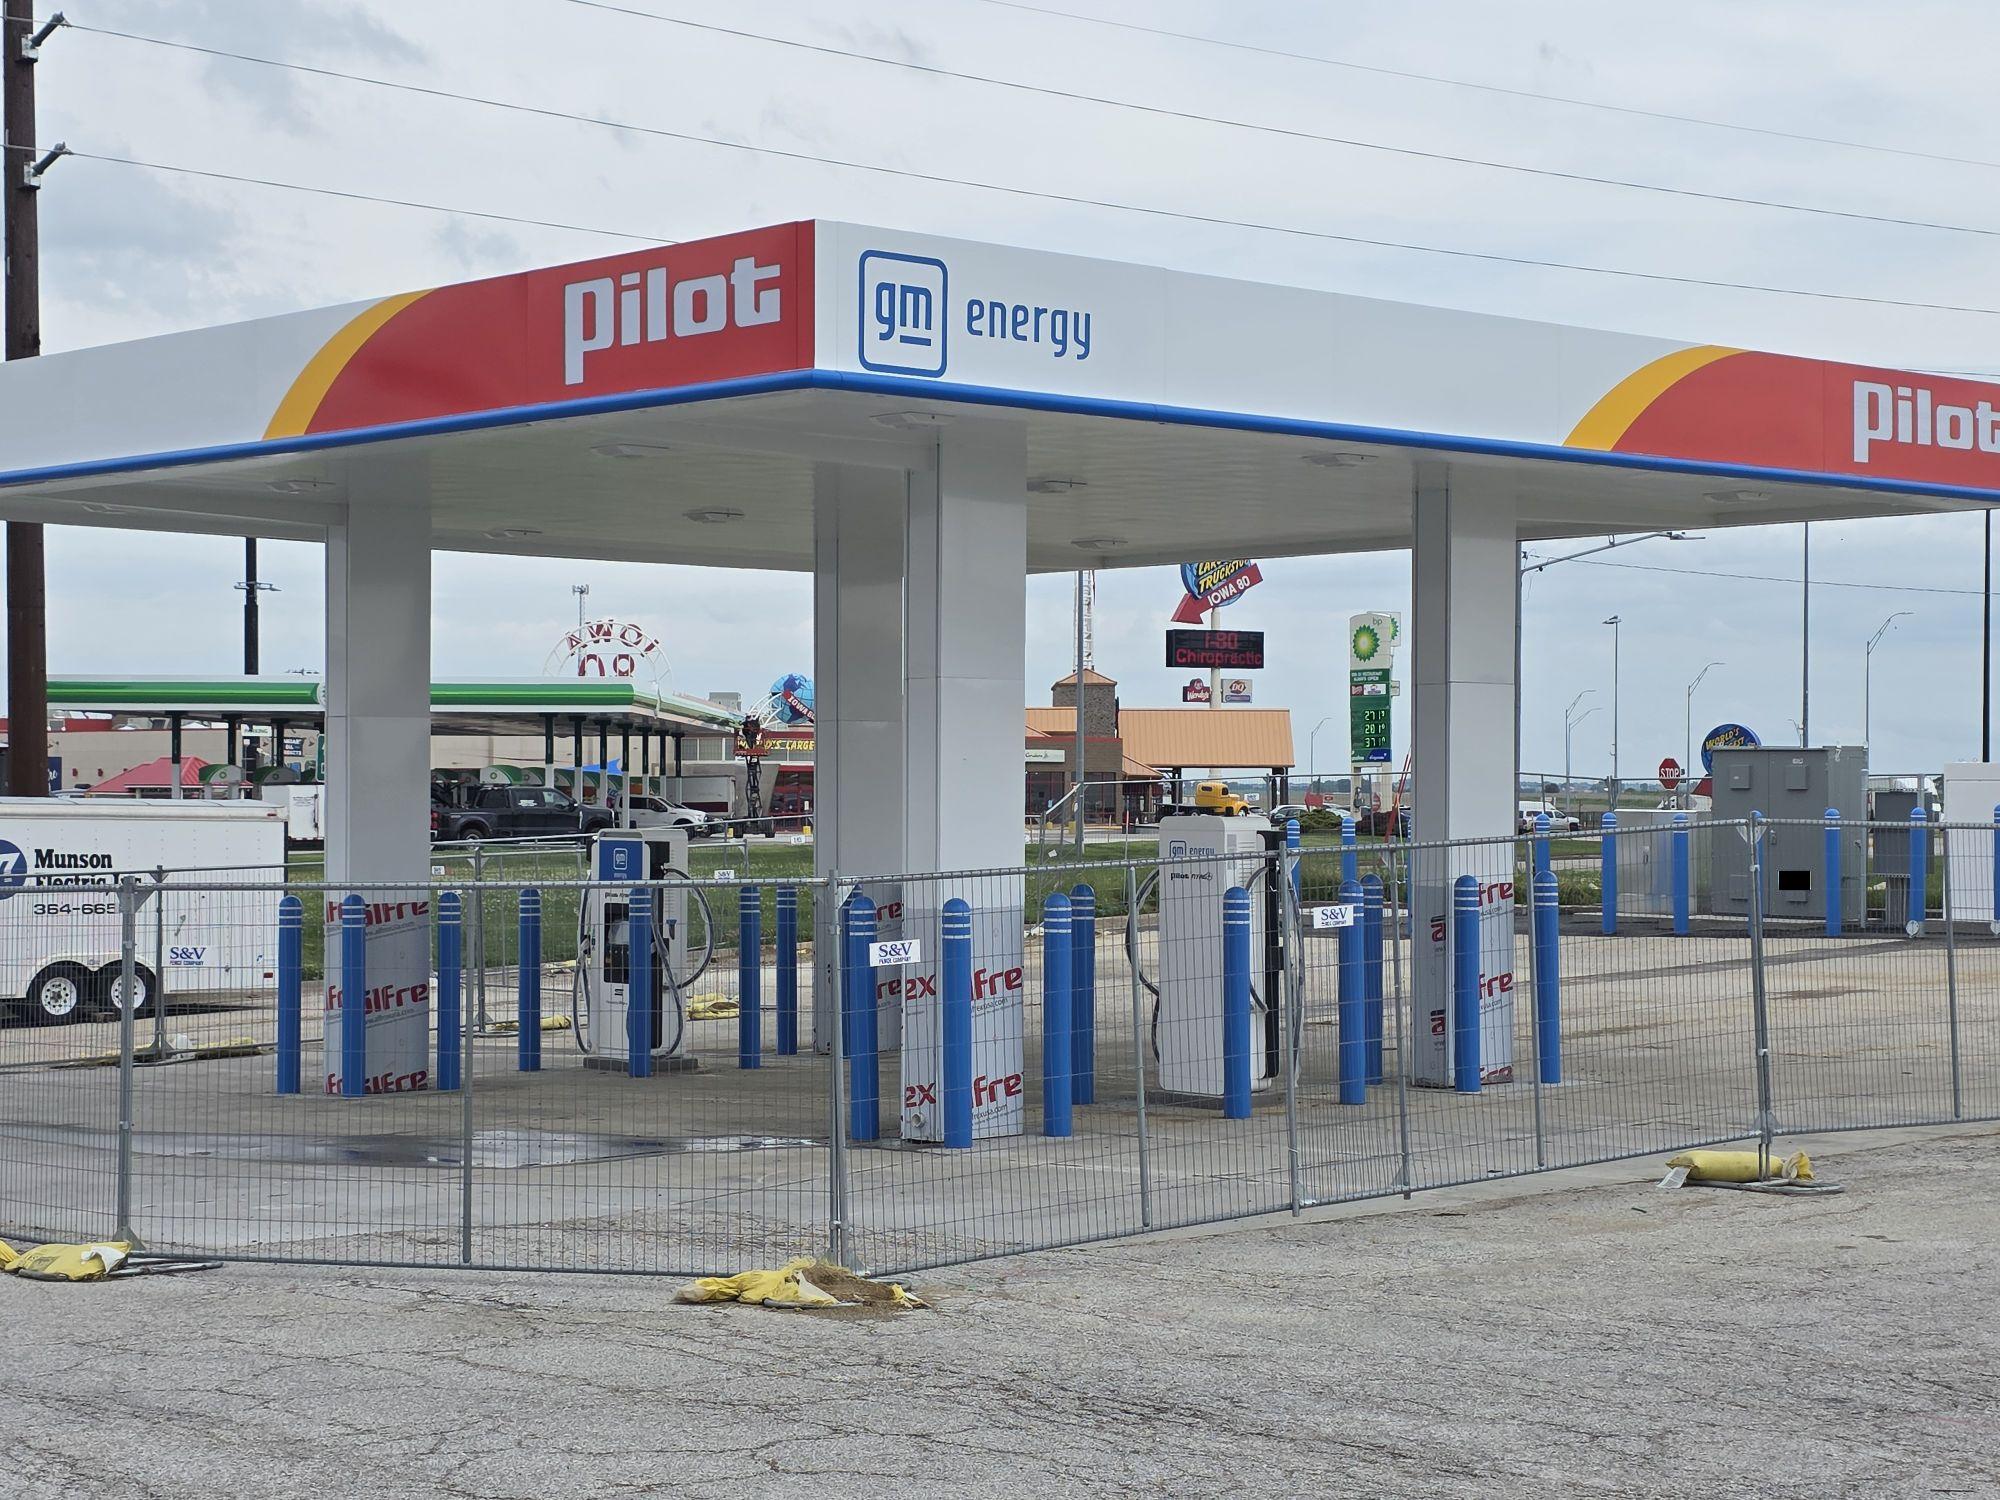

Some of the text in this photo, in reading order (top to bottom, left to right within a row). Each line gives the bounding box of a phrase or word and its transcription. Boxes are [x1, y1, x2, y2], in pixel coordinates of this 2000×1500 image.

[875, 281, 1091, 361] gm energy
[1207, 575, 1251, 606] IOWA 80
[1372, 617, 1383, 627] bp
[1175, 648, 1262, 666] Chiropractic
[787, 694, 807, 716] IOWA
[1660, 767, 1680, 778] STOP
[34, 848, 113, 869] Munson
[33, 903, 116, 915] 364-665
[877, 901, 903, 922] re
[1320, 907, 1348, 921] S&V
[169, 946, 207, 960] S&V
[878, 942, 912, 958] S&V
[877, 978, 902, 1000] re
[971, 966, 1023, 1001] fre
[971, 1072, 1023, 1109] fre
